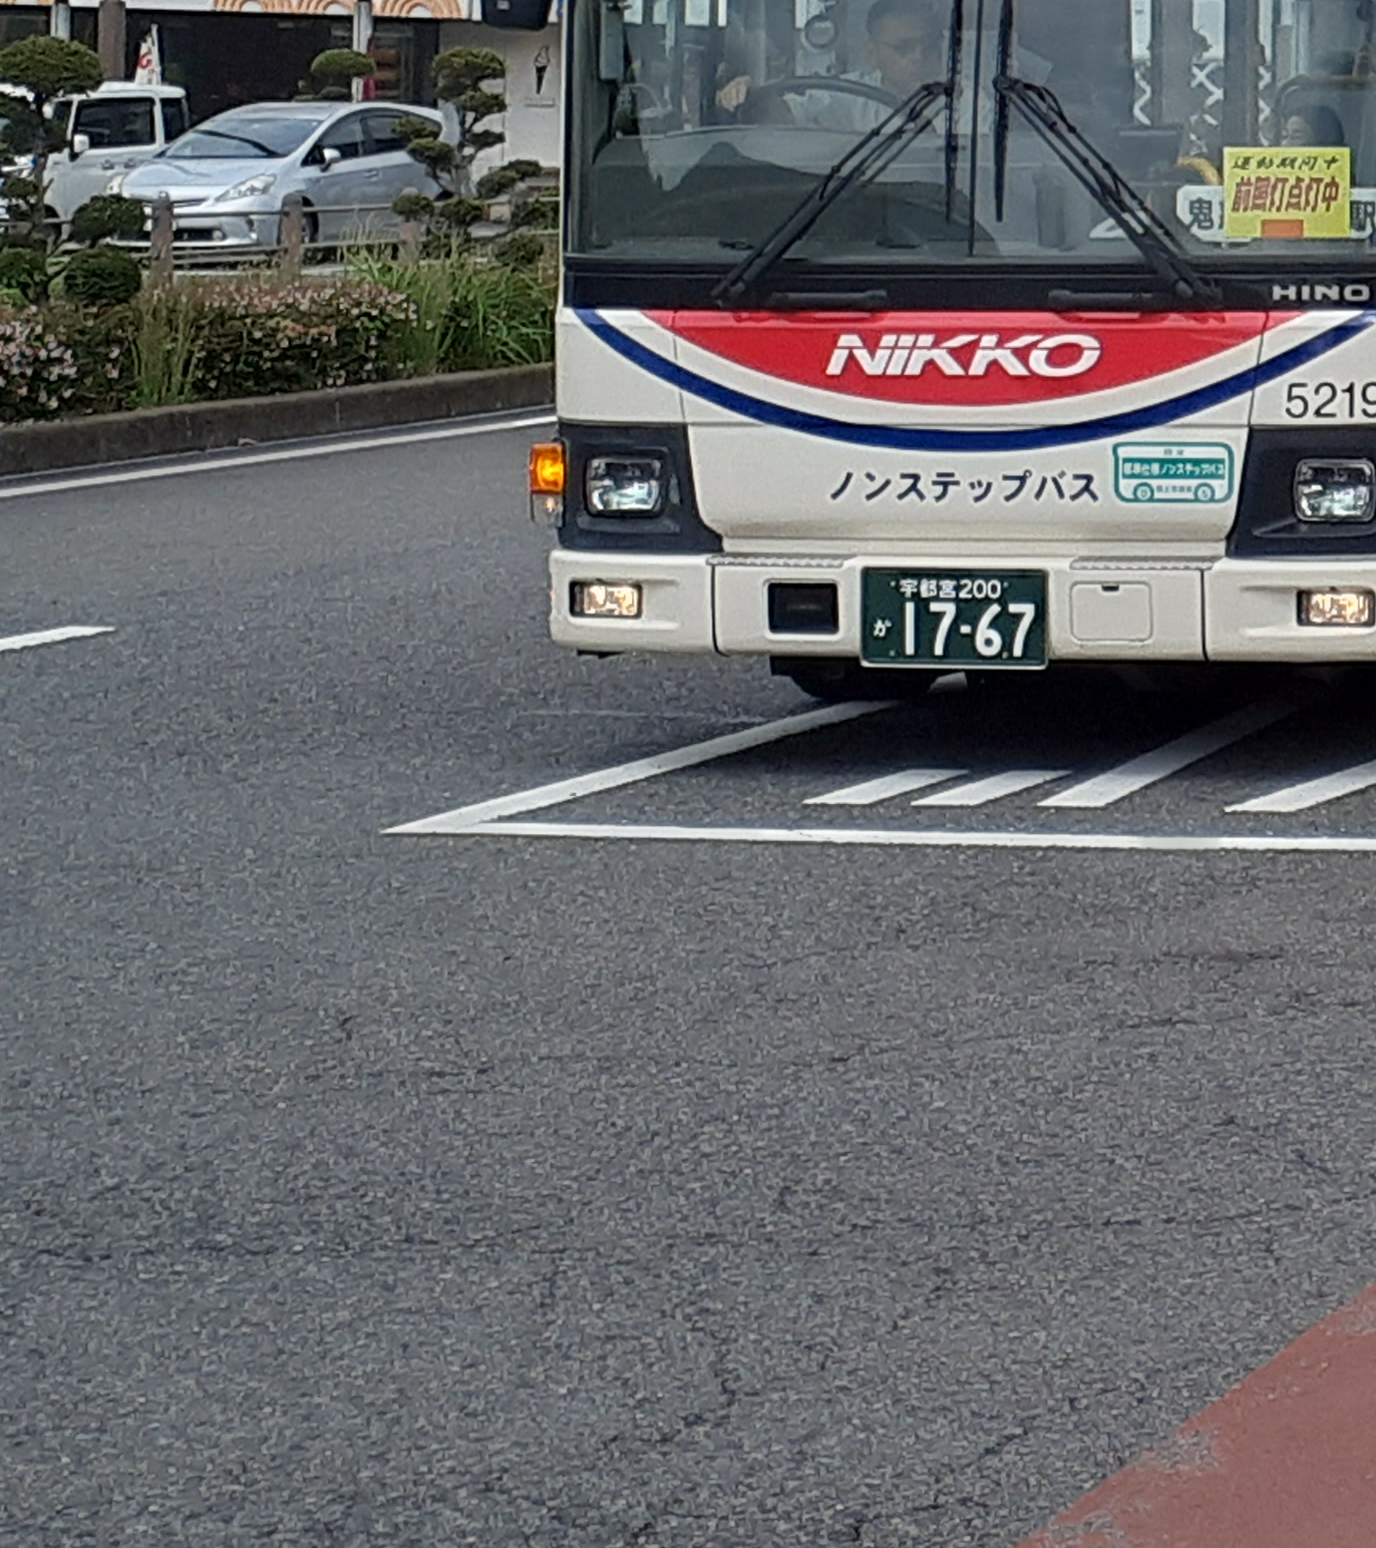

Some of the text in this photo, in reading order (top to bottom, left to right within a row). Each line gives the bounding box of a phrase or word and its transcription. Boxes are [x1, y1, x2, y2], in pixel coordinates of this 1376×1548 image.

[1271, 283, 1371, 302] HINO
[825, 333, 1101, 377] NIKKO
[829, 470, 1100, 503] ノンステップバス
[904, 601, 1037, 658] 17-67
